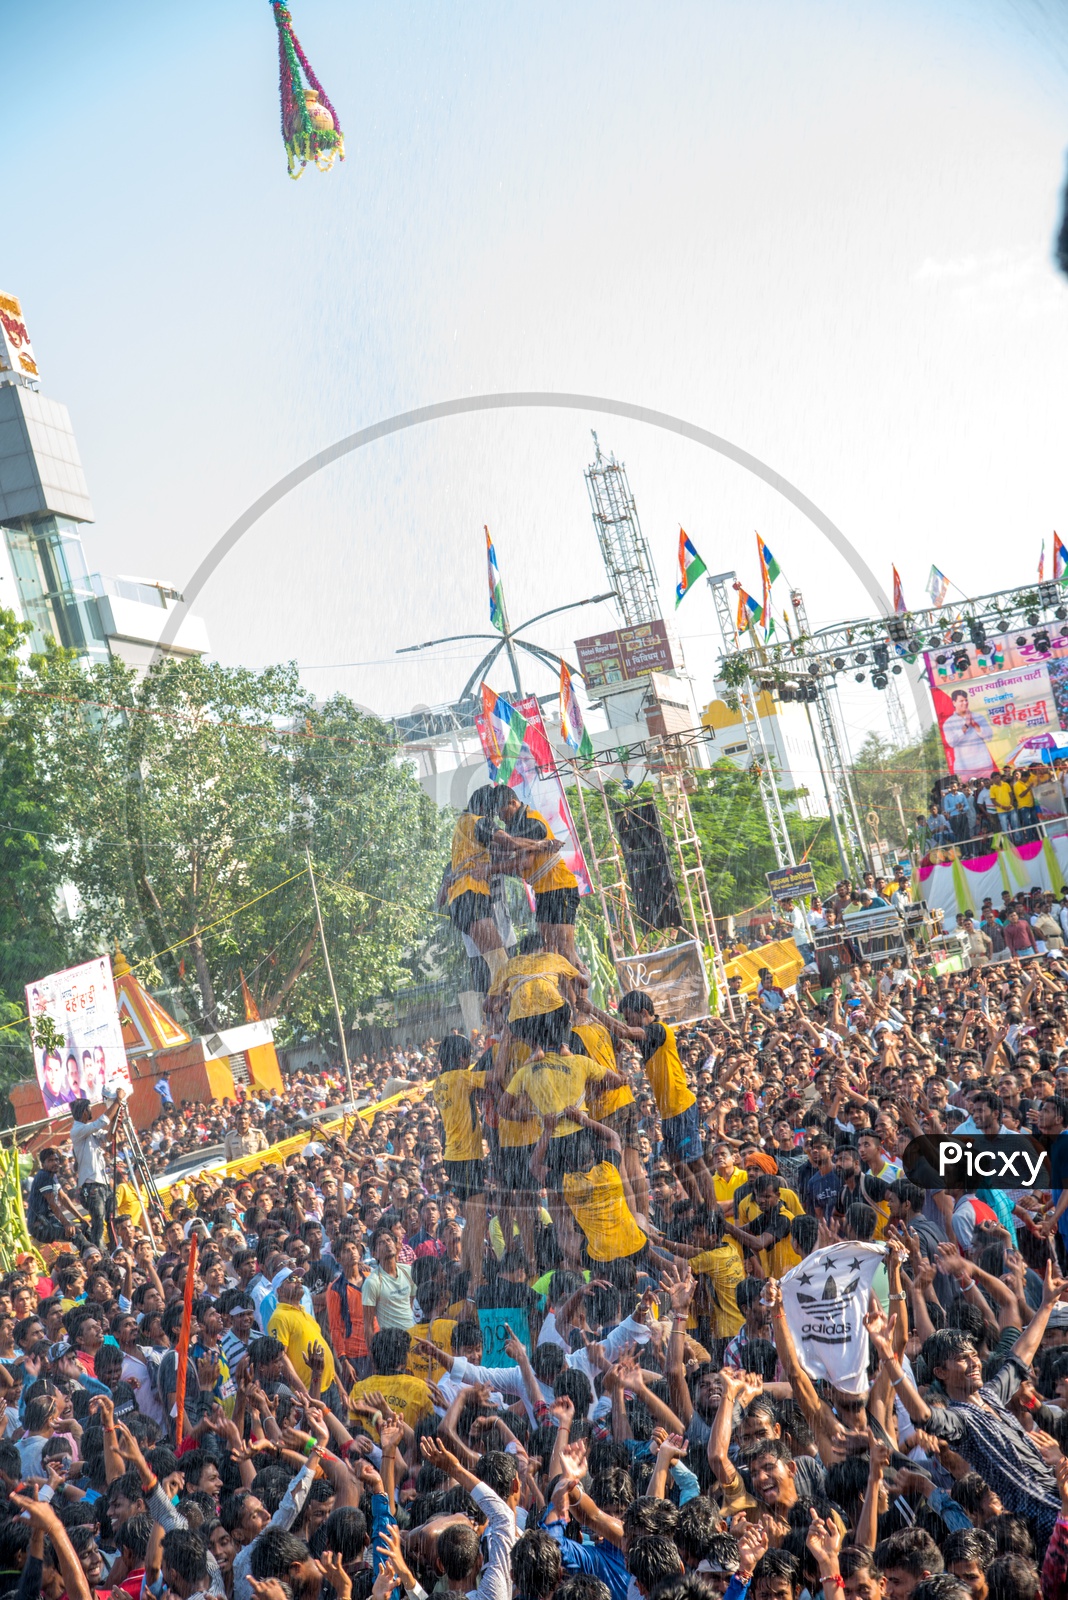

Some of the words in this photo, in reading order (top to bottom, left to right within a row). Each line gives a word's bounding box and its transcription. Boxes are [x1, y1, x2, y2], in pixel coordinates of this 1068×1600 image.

[581, 648, 594, 657] Hotel
[595, 645, 609, 653] Royal
[968, 686, 984, 697] युवा
[985, 676, 1022, 690] स्वाभिमान
[1024, 669, 1042, 681] पार्टी
[992, 700, 1049, 726] दहीहांडी
[801, 1320, 852, 1334] adidas
[388, 1395, 408, 1408] GROUP
